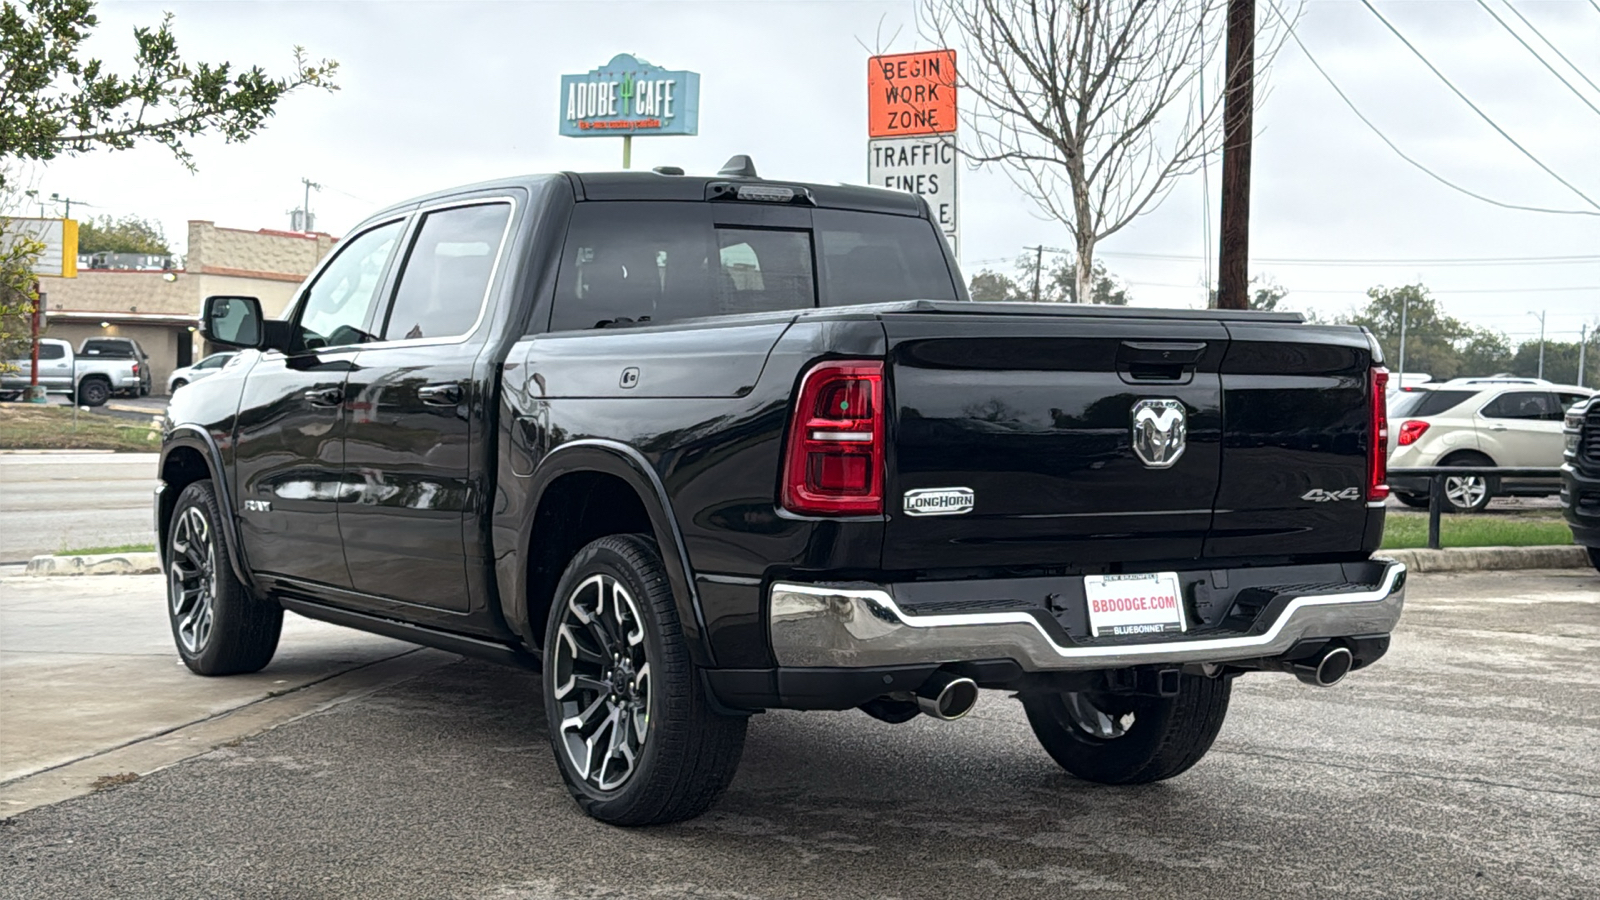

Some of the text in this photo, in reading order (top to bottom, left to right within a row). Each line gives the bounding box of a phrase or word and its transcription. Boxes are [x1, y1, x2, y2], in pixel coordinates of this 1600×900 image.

[884, 58, 940, 80] BEGIN
[567, 80, 676, 120] ADOBE CAFE
[885, 83, 939, 105] WORK
[887, 108, 939, 130] ZONE
[873, 143, 952, 168] TRAFFIC
[1092, 595, 1176, 613] BBDODGE.COM
[1113, 624, 1165, 635] BLUEBONNET
